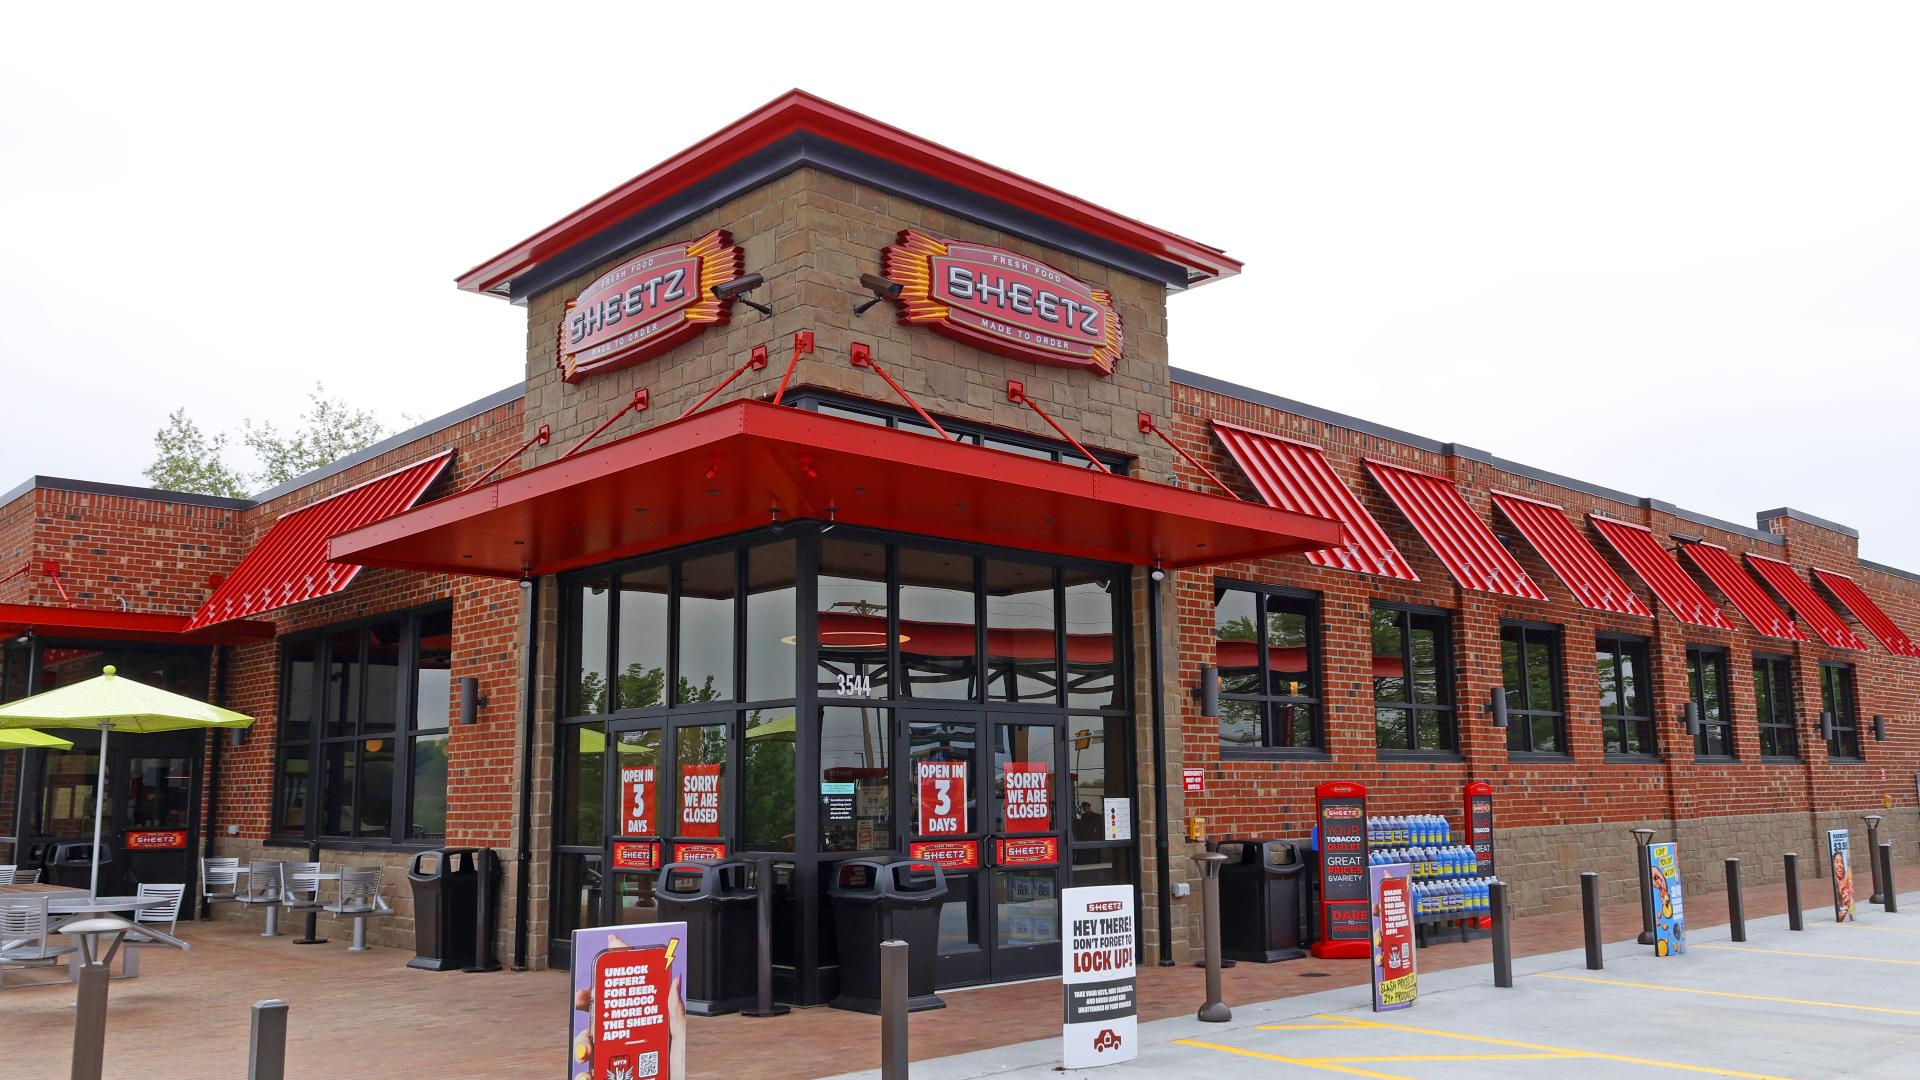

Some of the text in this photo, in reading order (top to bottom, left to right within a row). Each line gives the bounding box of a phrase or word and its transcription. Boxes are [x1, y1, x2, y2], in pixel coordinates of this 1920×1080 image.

[601, 258, 654, 288] FRESH FOOD
[993, 255, 1061, 283] FRESH FOOD
[570, 267, 685, 344] SHEETZ
[948, 265, 1099, 336] SHEETZ
[615, 338, 624, 347] TO
[629, 323, 657, 341] ORDER
[981, 319, 1069, 350] MADE TO ORDER
[836, 674, 872, 696] 3544
[624, 769, 653, 783] OPEN IN
[921, 764, 964, 778] OPEN IN
[684, 775, 719, 792] SORRY
[1006, 772, 1047, 789] SORRY
[632, 783, 645, 818] 3
[684, 792, 718, 807] WE ARE
[934, 779, 951, 816] 3
[1007, 789, 1047, 804] WE ARE
[683, 808, 718, 823] CLOSED
[1007, 803, 1047, 819] CLOSED
[628, 820, 648, 832] DAYS
[929, 817, 957, 832] DAYS
[1327, 825, 1360, 836] YOUR
[924, 850, 964, 860] SHEETZ
[1008, 846, 1046, 856] SHEETZ
[1327, 856, 1362, 866] GREAT
[1327, 866, 1363, 875] PRICES
[1328, 874, 1362, 882] &VARIETY
[1089, 902, 1121, 911] SHEETZ
[1332, 910, 1367, 920] DARE
[1073, 916, 1131, 936] HEY THERE!
[1073, 934, 1132, 950] DON'T FORGET TO
[1074, 947, 1132, 973] LOCK UP!
[604, 965, 648, 977] UNLOCK
[604, 975, 646, 987] OFFERZ
[604, 985, 657, 998] FOR BEER,
[604, 995, 654, 1009] TOBACCO
[611, 1007, 642, 1019] MORE
[644, 1005, 658, 1015] ON
[603, 1014, 663, 1030] THE SHEETZ
[603, 1029, 630, 1041] APP!
